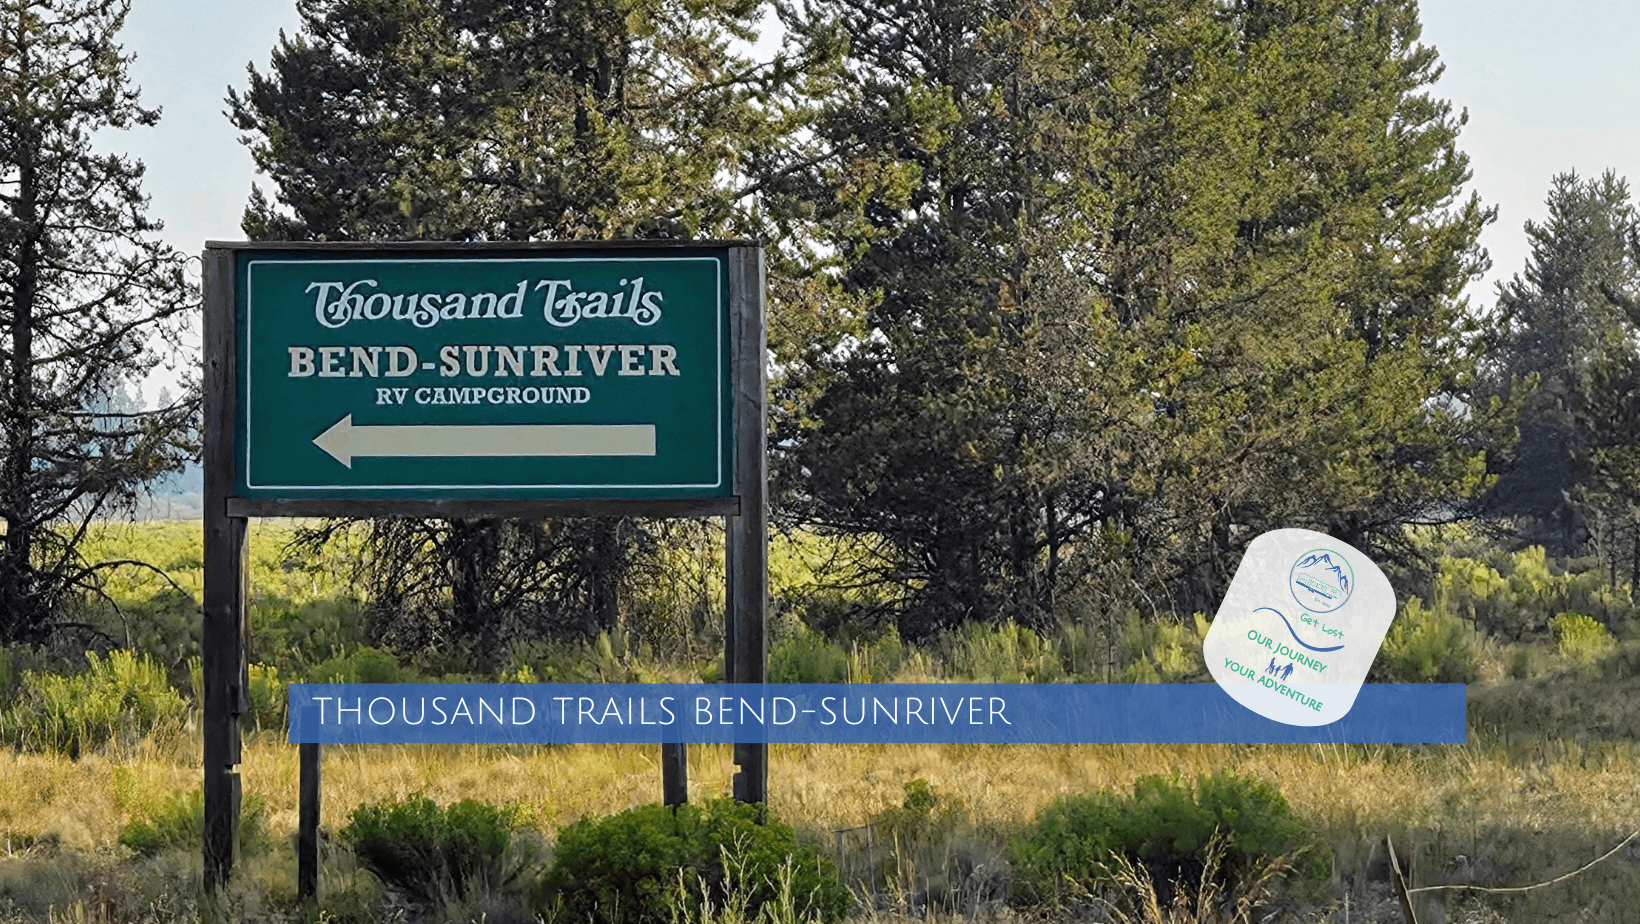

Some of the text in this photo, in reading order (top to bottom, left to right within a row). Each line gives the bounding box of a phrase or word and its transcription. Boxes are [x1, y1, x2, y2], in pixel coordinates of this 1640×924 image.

[305, 276, 663, 328] Thousand Trails
[287, 344, 681, 378] BEND-SUNRIVER
[375, 386, 591, 405] RV CAMPGROUND
